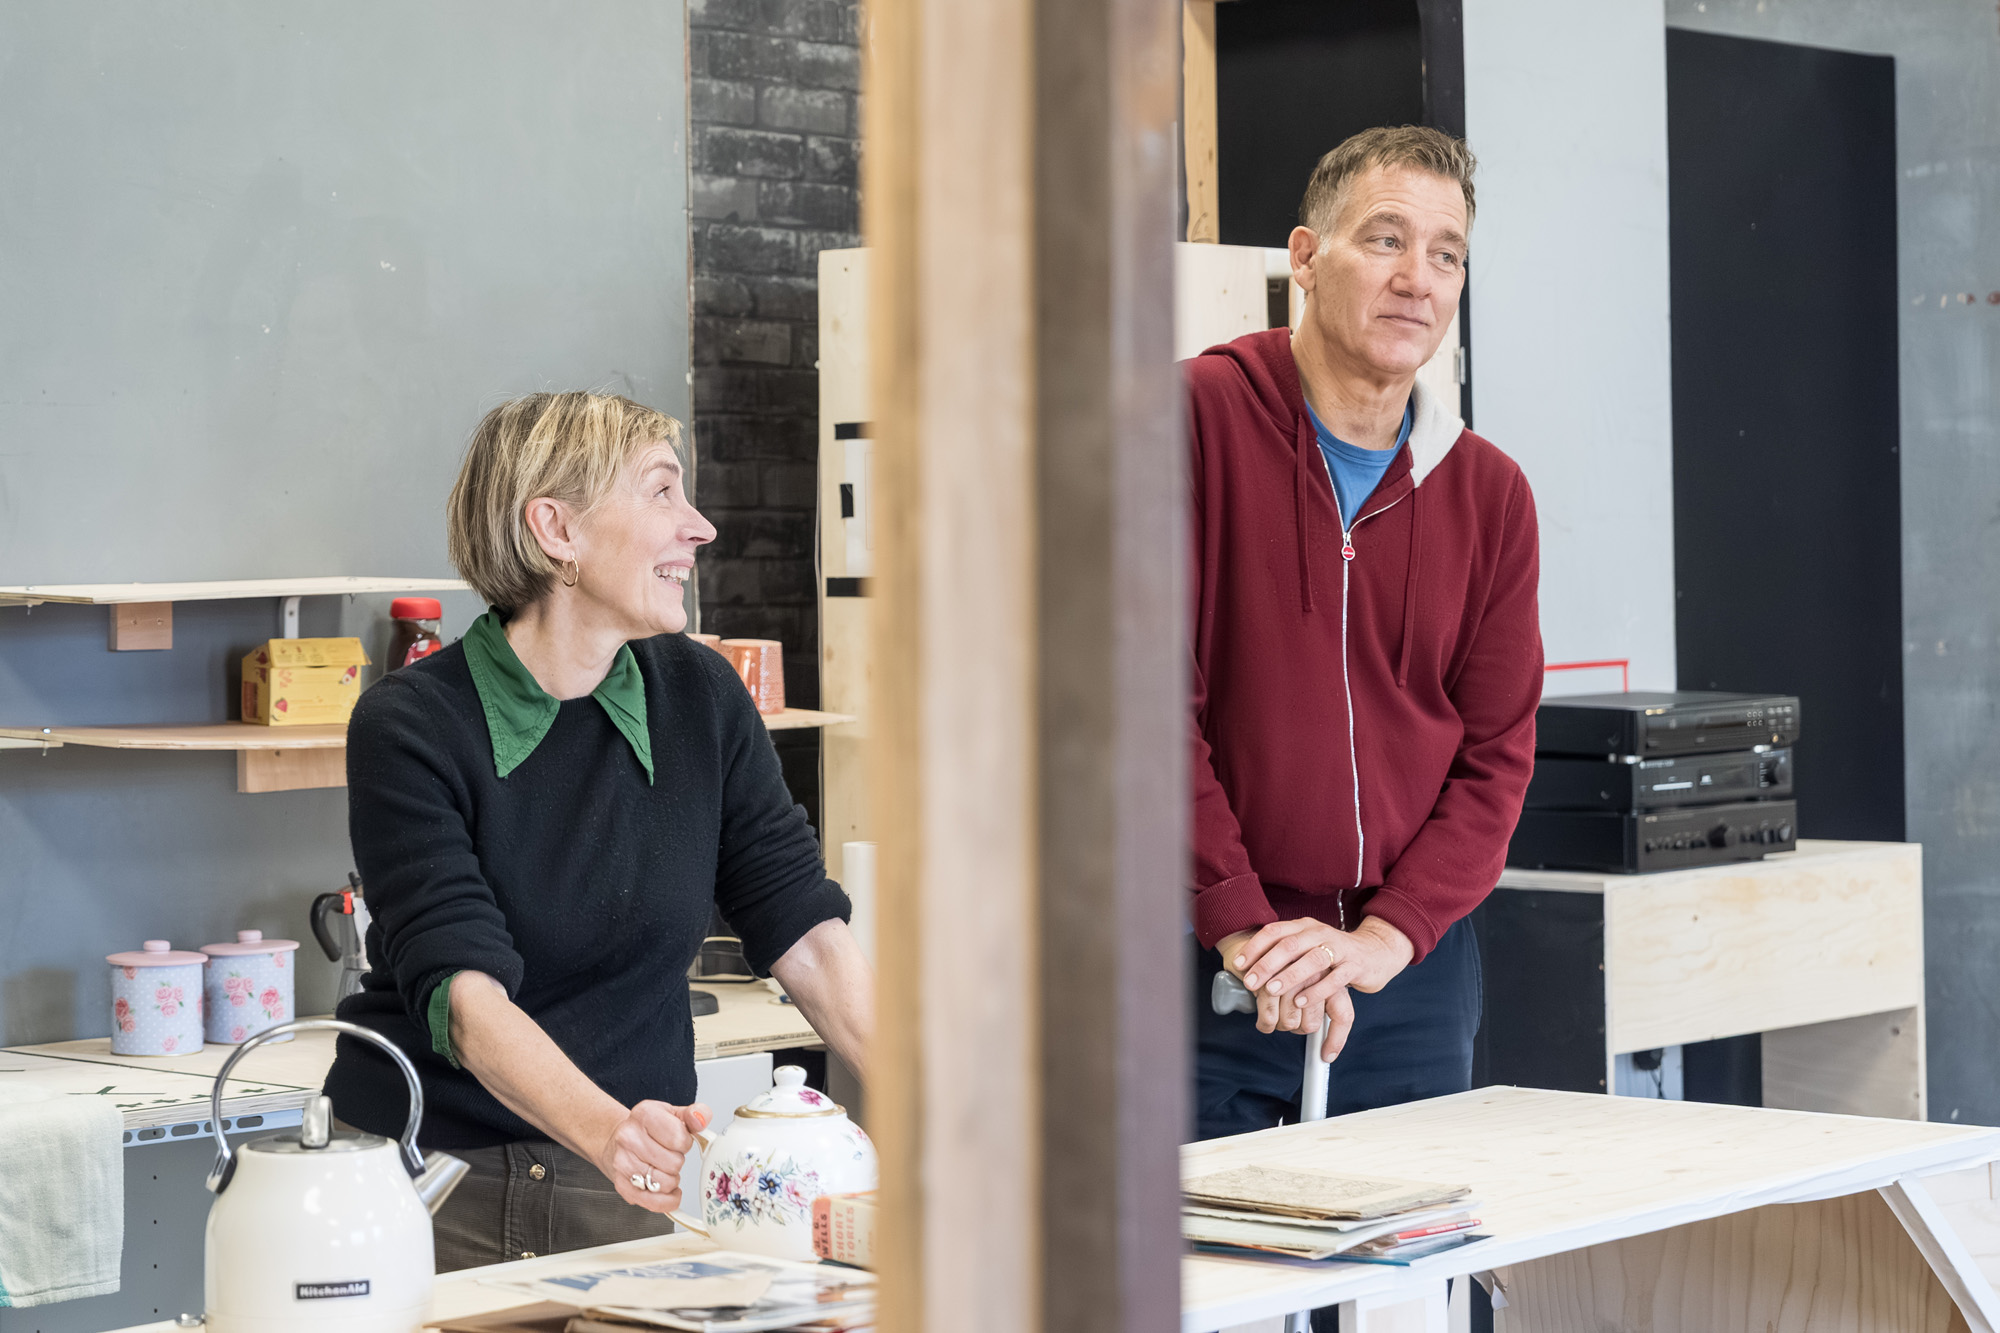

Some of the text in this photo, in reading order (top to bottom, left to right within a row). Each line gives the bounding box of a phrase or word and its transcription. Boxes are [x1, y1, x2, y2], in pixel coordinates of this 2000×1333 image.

[821, 1214, 829, 1255] WELLS
[836, 1212, 845, 1260] SHORT
[847, 1207, 856, 1258] TORIES
[299, 1283, 367, 1297] KitchenAid
